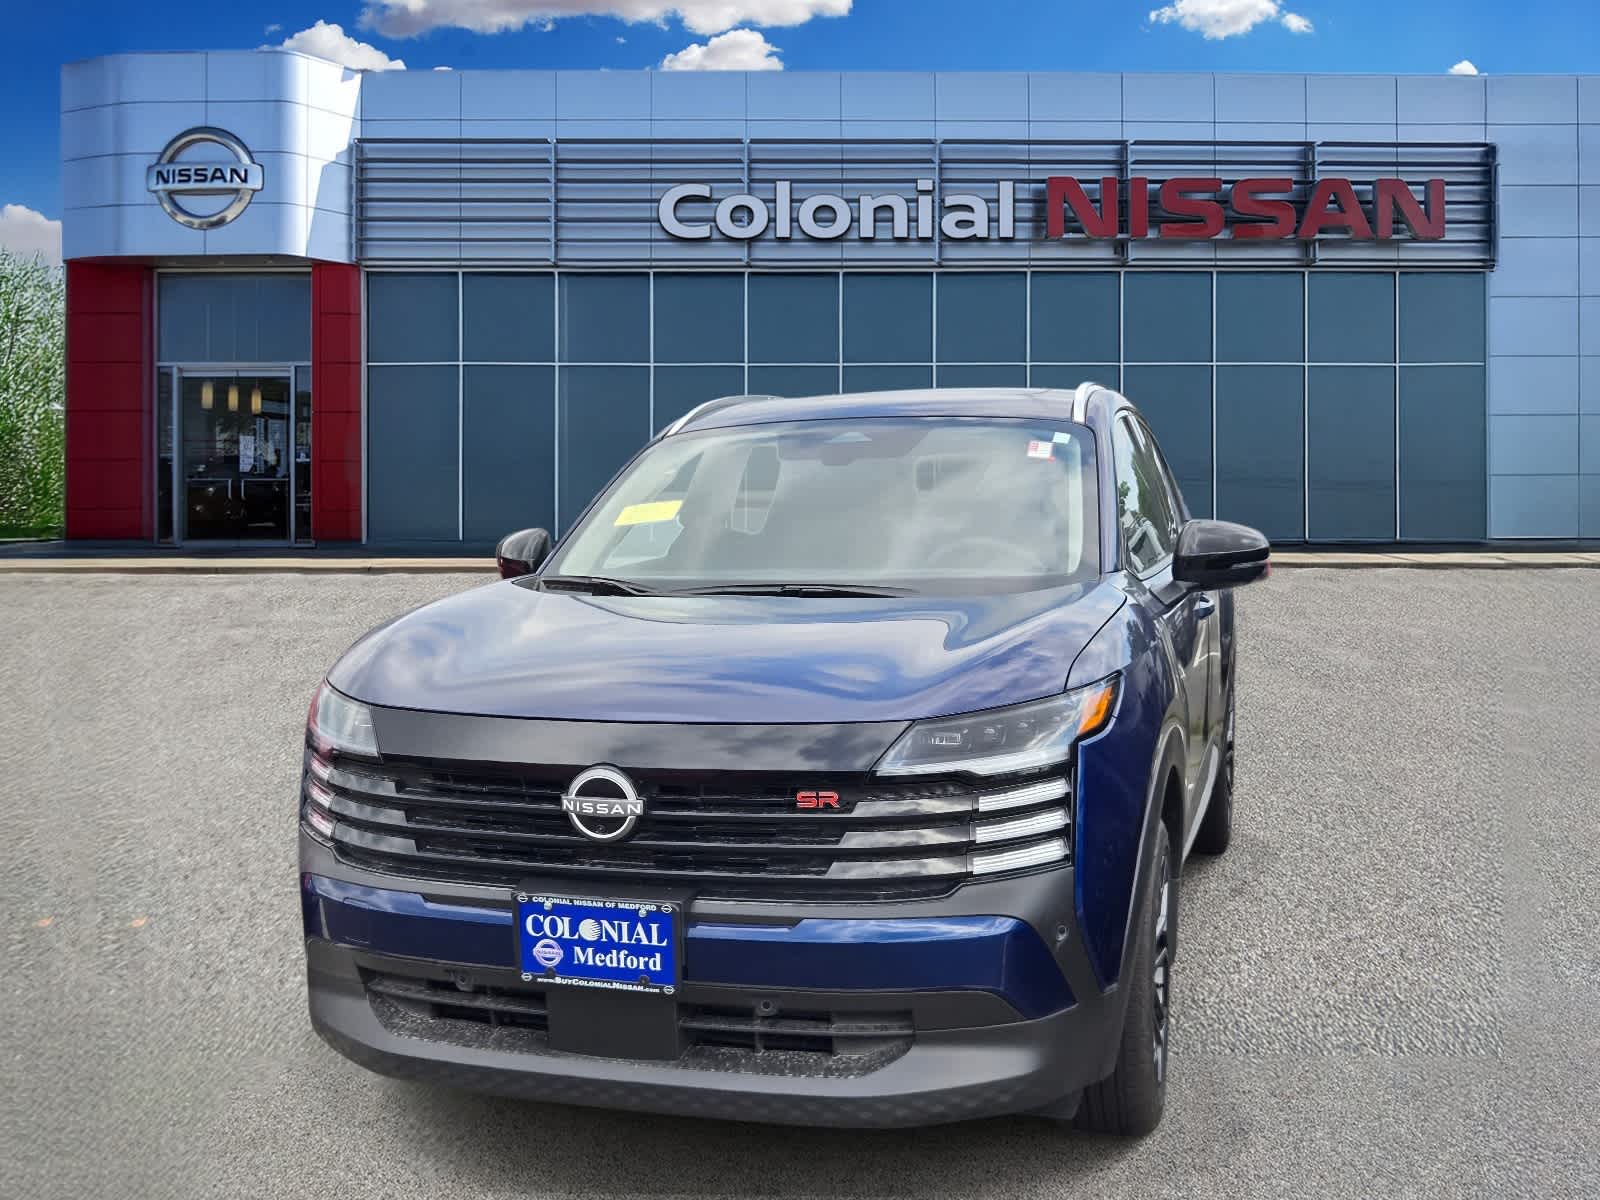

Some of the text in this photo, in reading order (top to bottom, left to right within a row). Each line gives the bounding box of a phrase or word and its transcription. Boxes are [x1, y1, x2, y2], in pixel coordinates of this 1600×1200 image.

[156, 168, 248, 184] NISSAN
[658, 176, 1446, 240] Colonial NISSAN
[562, 799, 642, 815] NISSAN
[796, 791, 840, 808] SR
[532, 896, 573, 905] COLONIAL
[573, 899, 604, 907] NISSAN
[618, 902, 657, 911] MEDFORD
[525, 913, 668, 947] COLONIAL
[573, 946, 662, 971] Medford
